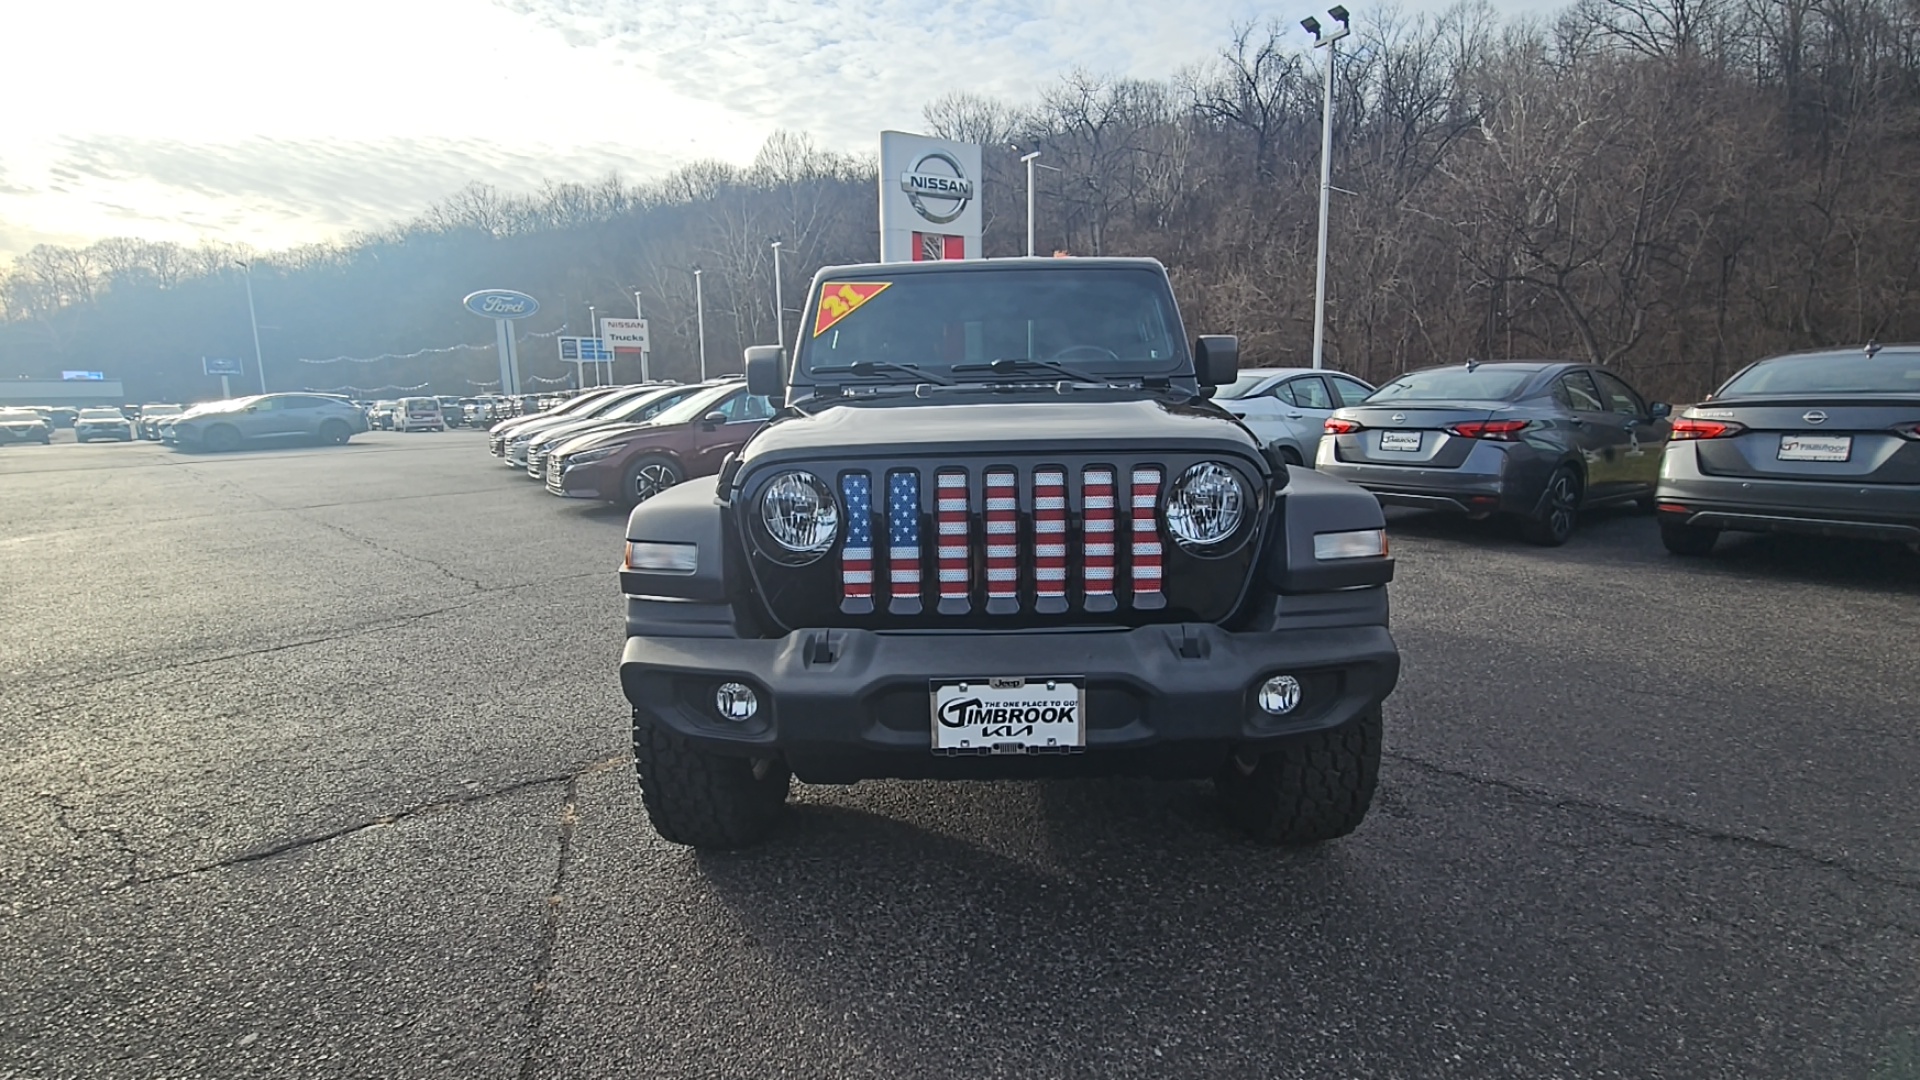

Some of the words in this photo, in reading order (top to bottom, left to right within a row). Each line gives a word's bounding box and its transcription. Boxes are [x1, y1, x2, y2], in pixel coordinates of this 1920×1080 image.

[911, 176, 968, 193] NISSAN
[482, 295, 525, 312] Ford
[823, 284, 865, 318] 21
[609, 333, 644, 341] Trucks
[994, 679, 1020, 689] Jeep
[938, 698, 1076, 728] TIMBROOK
